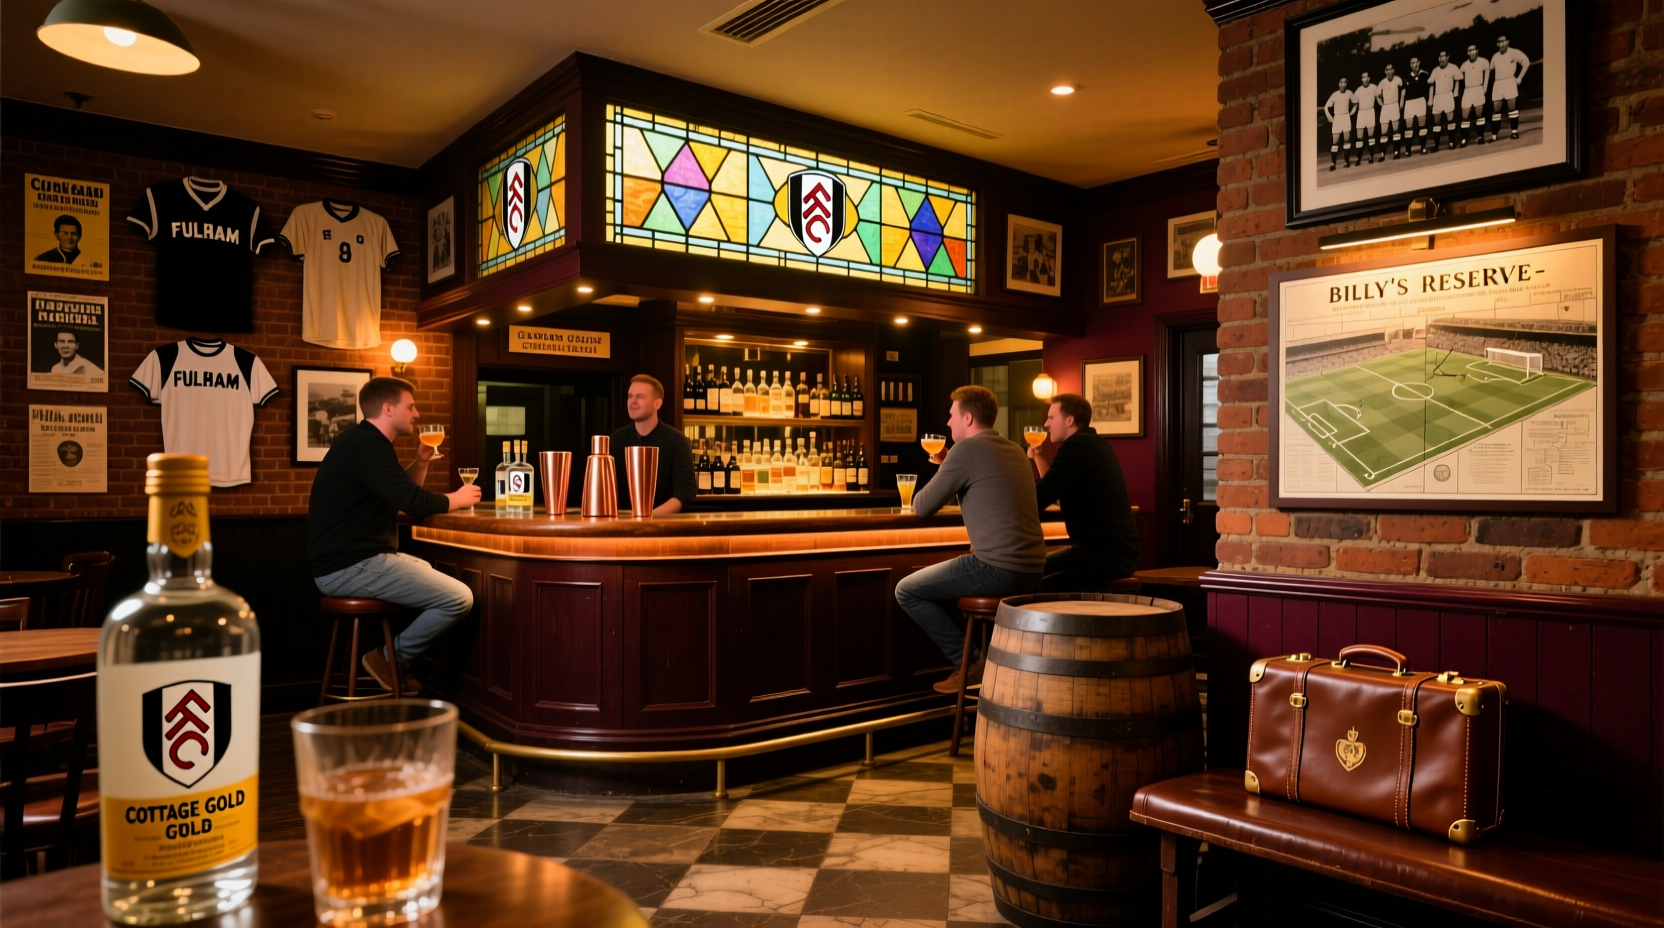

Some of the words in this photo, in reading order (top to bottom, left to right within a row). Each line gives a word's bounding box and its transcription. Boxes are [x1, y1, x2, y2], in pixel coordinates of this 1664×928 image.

[1329, 277, 1409, 304] BILLY'S
[173, 370, 239, 390] FULHAM
[125, 800, 200, 824] COTTAGE
[205, 789, 245, 814] GOLD
[165, 818, 212, 840] GOLD
